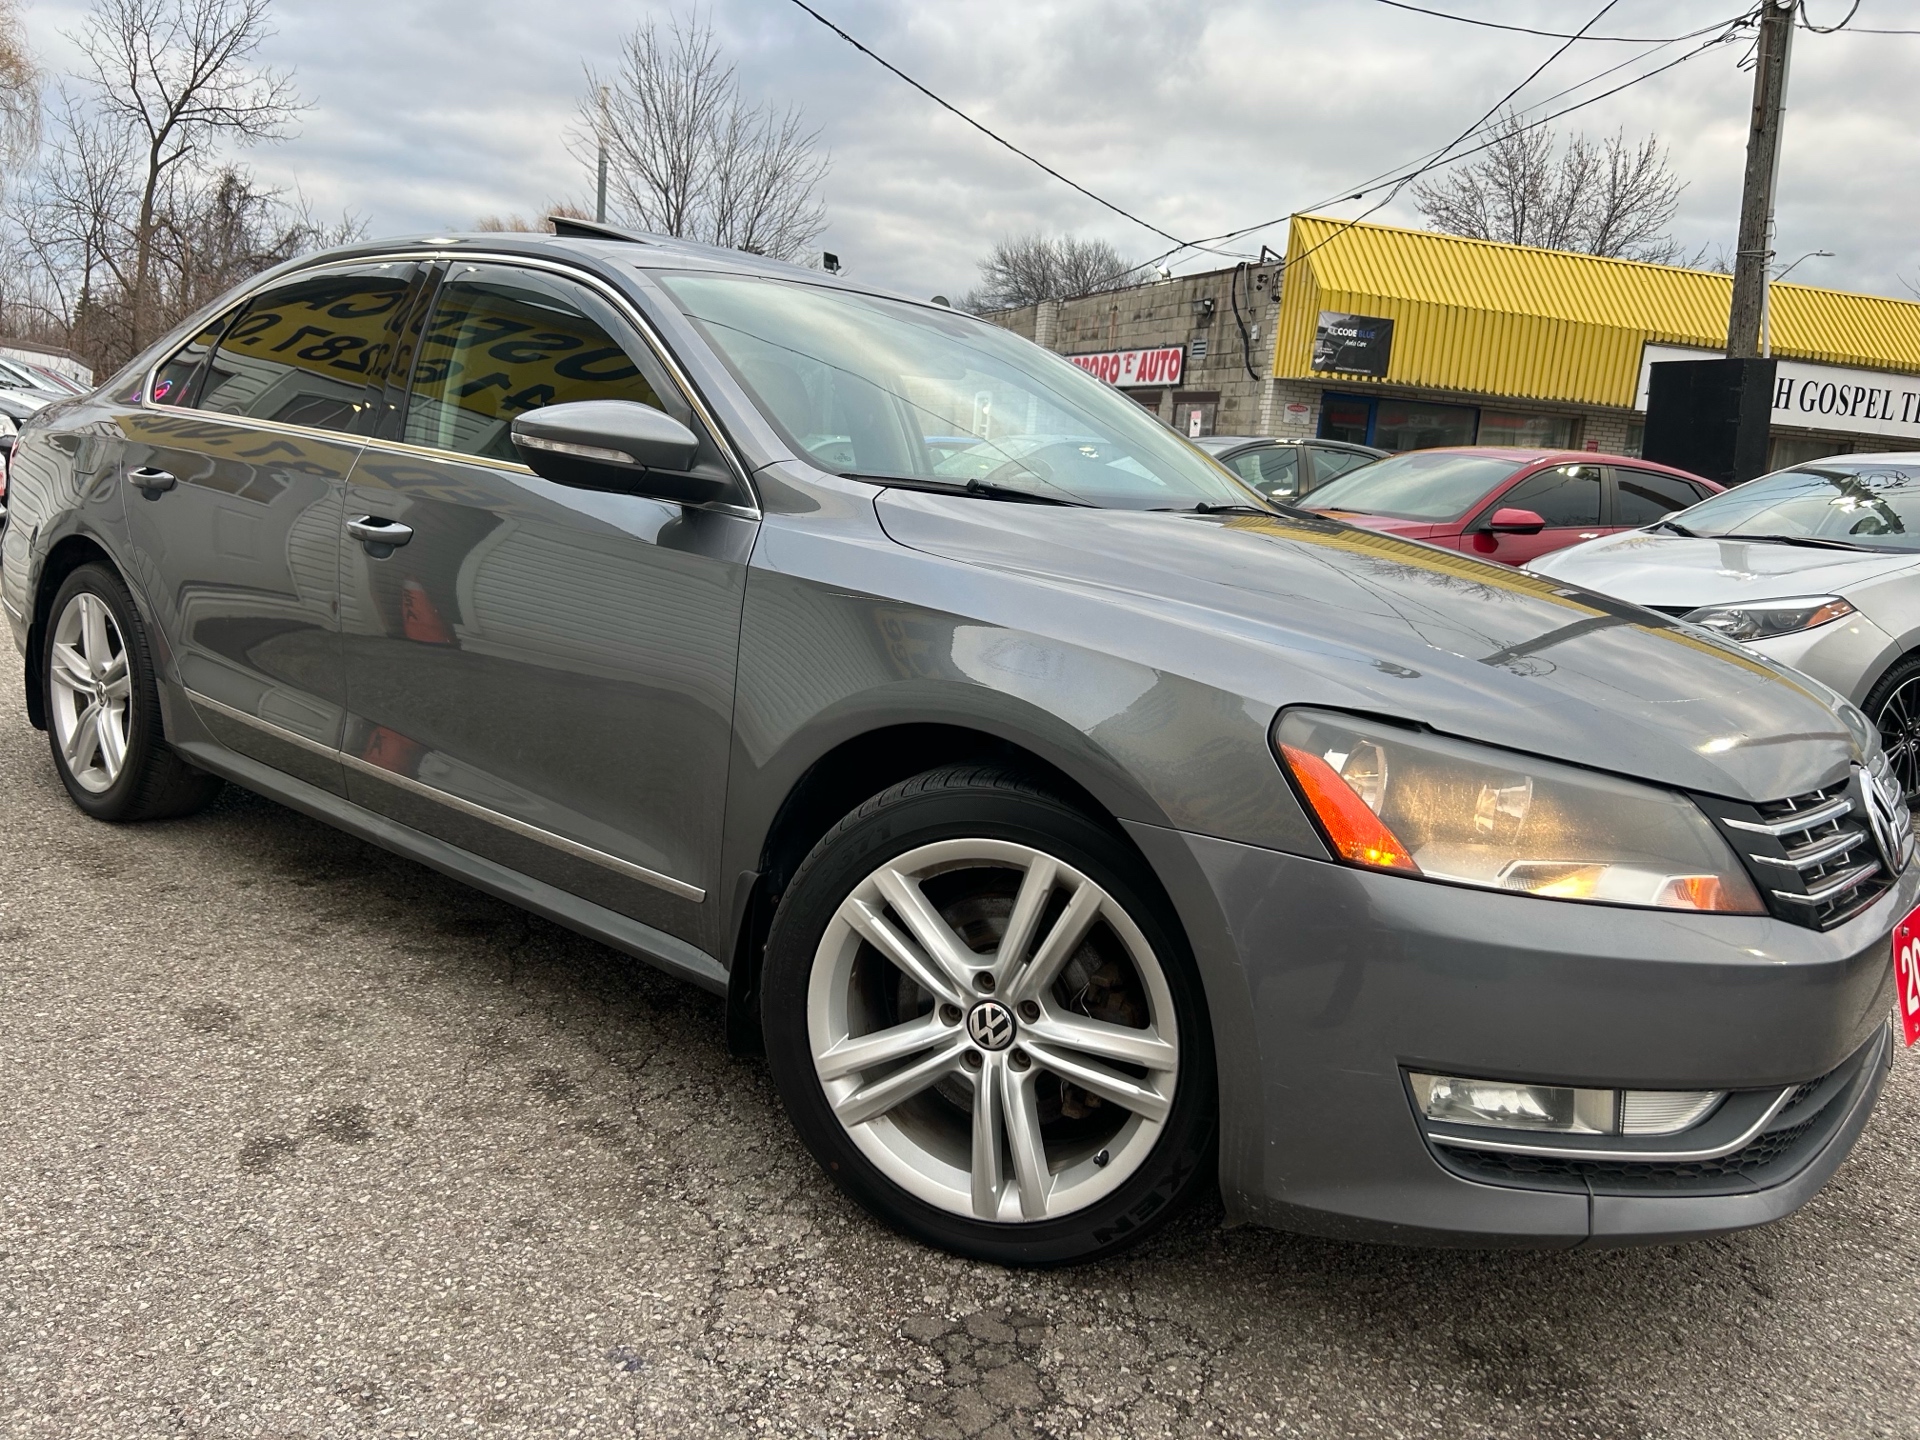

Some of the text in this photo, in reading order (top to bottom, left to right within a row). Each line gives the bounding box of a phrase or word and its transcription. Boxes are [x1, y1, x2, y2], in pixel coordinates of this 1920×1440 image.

[1337, 327, 1358, 338] CODE
[1135, 349, 1181, 382] AUTO
[1799, 380, 1895, 421] GOSPEL
